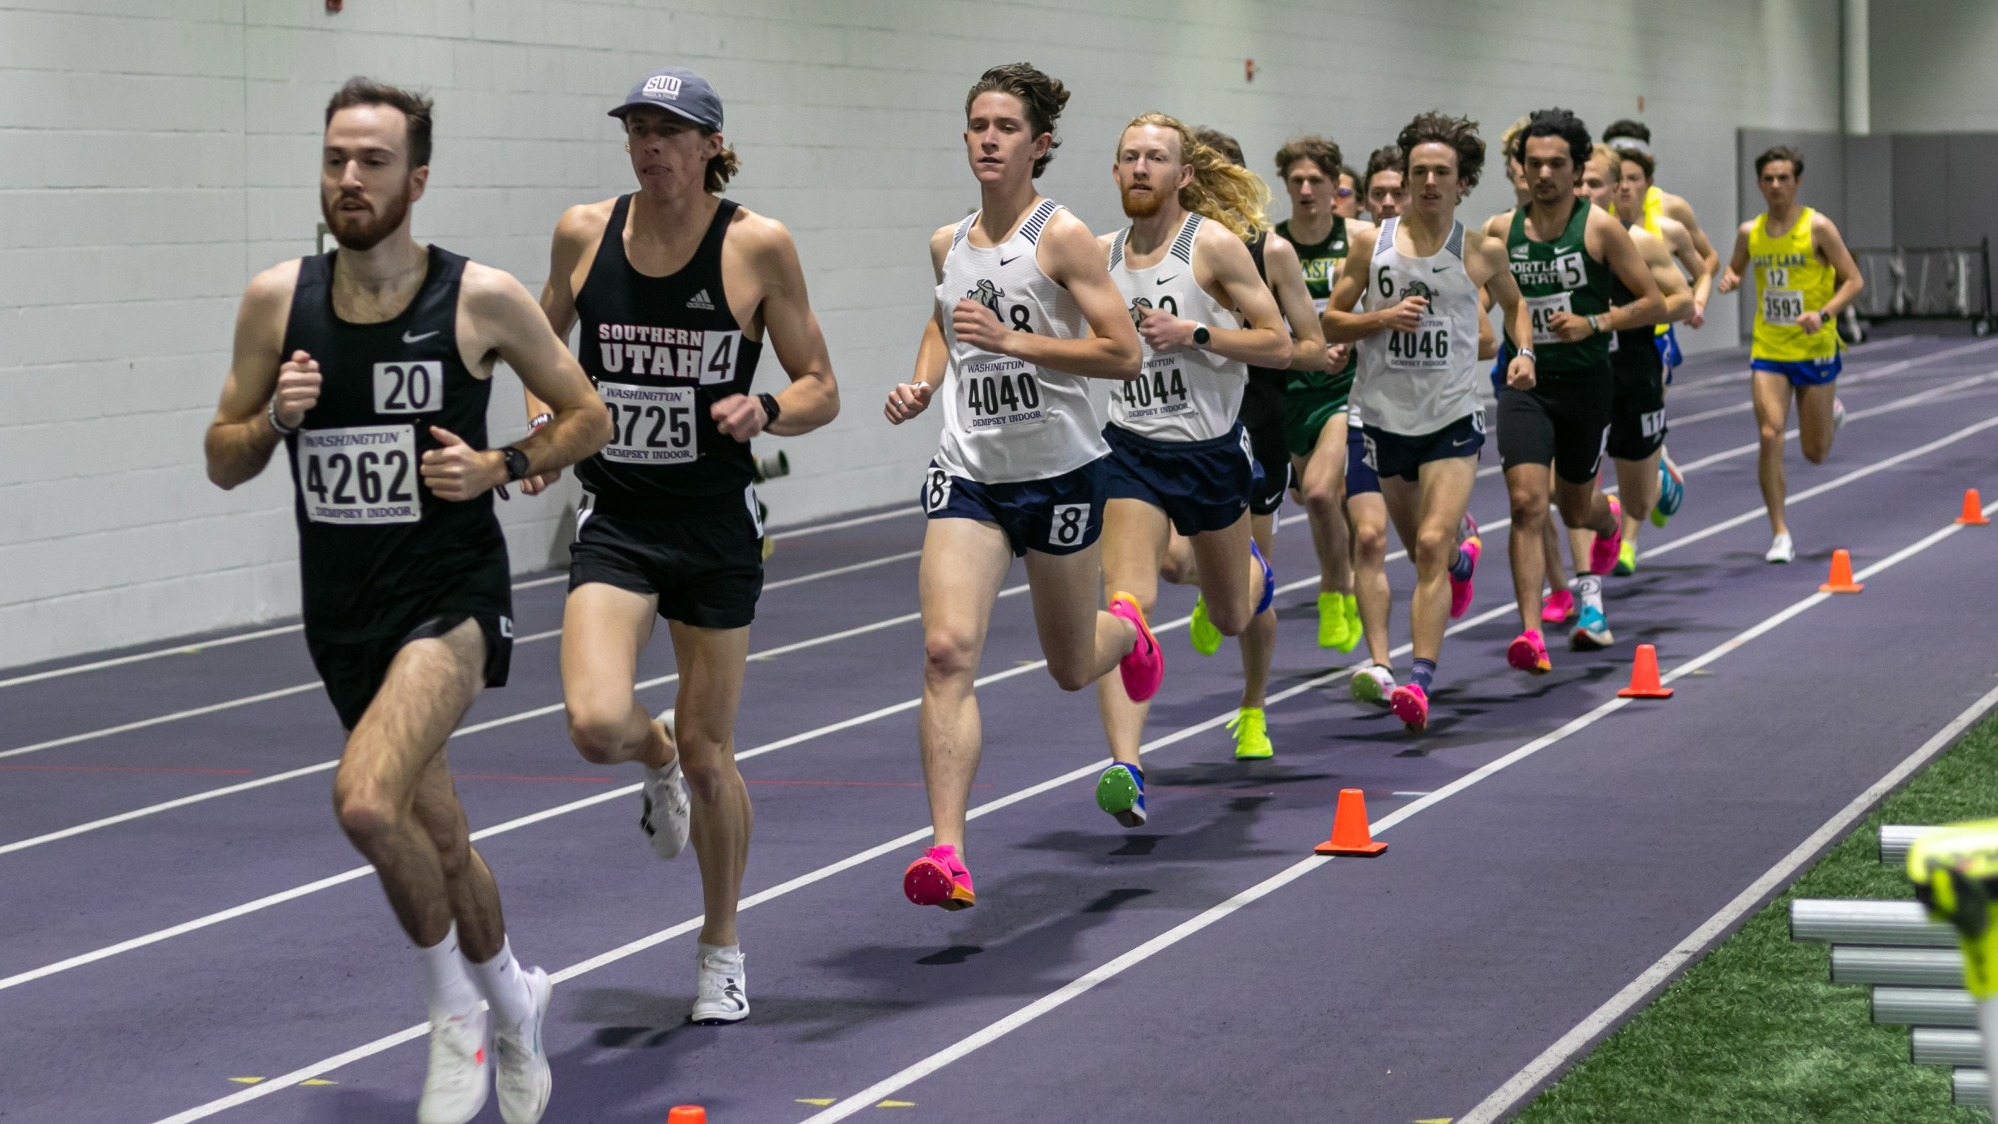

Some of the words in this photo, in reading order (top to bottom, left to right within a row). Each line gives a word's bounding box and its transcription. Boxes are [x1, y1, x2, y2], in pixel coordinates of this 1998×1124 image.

[648, 77, 679, 92] SUU
[1301, 260, 1335, 278] ASK
[1509, 260, 1559, 274] ORTLA
[1564, 257, 1581, 285] 5
[1378, 265, 1394, 298] 6
[1770, 270, 1785, 287] 12
[1765, 297, 1802, 317] 3593
[1010, 304, 1034, 333] 8
[599, 323, 703, 347] SOUTHERN
[1388, 329, 1448, 359] 4046
[599, 343, 702, 379] UTAH
[708, 335, 733, 380] 4
[967, 360, 1025, 374] WASHINGTON
[1142, 357, 1175, 369] INGTON
[384, 364, 431, 410] 20
[606, 387, 683, 402] WASHINGTON
[968, 372, 1040, 416] 4040
[1123, 368, 1187, 409] 4044
[972, 416, 1006, 427] DEMPSEY
[1008, 410, 1042, 423] INDOOR
[1128, 407, 1158, 418] DEMPSEY
[1160, 402, 1189, 415] INDOOR
[305, 431, 400, 448] WASHINGTON
[606, 447, 650, 459] DEMPSEY
[652, 449, 694, 460] INDOOR
[307, 450, 413, 505] 4262
[930, 469, 947, 508] 8
[315, 506, 363, 519] DEMPSEY
[367, 506, 411, 519] INDOOR
[1057, 506, 1082, 544] 8
